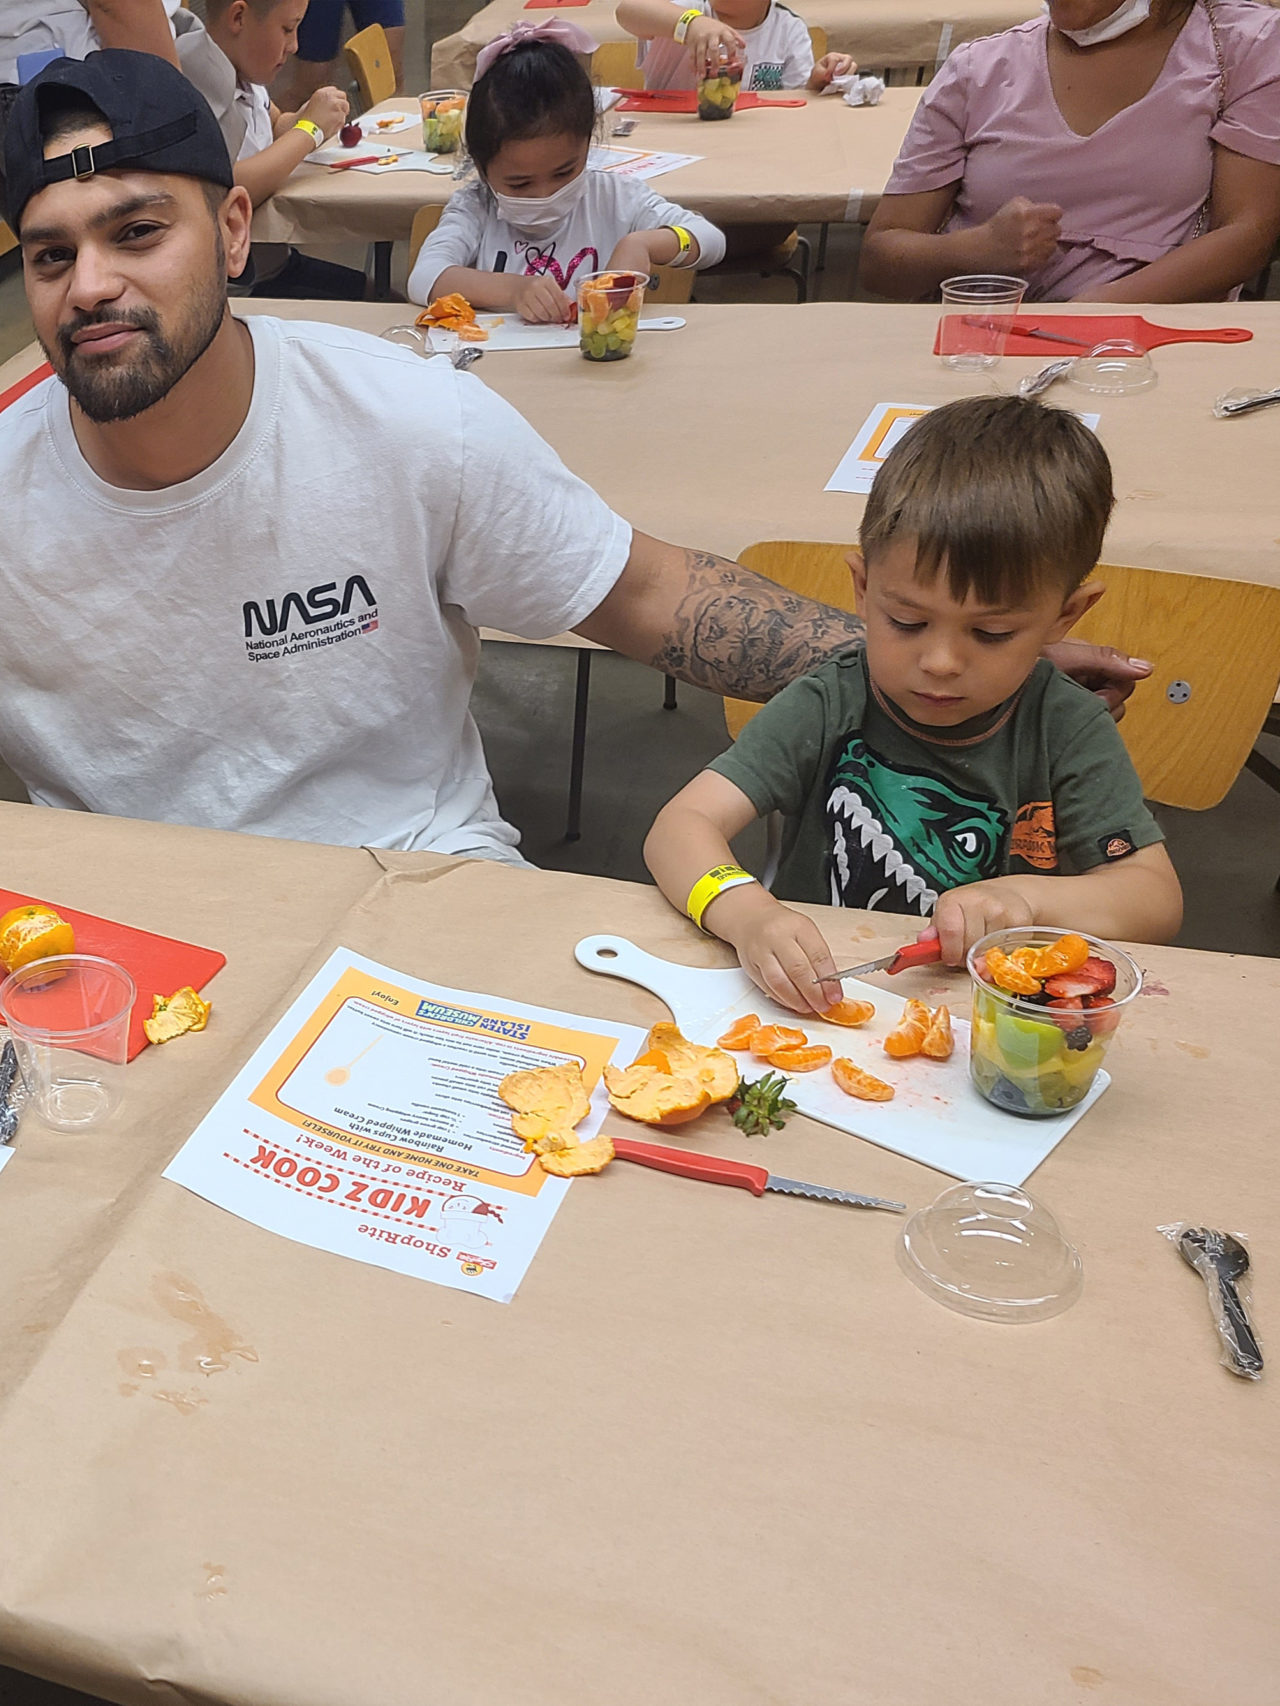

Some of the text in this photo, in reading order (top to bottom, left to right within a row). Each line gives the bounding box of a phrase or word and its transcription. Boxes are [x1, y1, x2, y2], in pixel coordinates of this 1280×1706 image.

[243, 575, 377, 637] NASA
[246, 608, 378, 650] National Aeronautics and
[248, 627, 362, 663] Space Administration
[421, 1001, 480, 1022] MUSEUM
[481, 1017, 531, 1032] ISLAND
[478, 1021, 529, 1040] STATEN
[333, 1106, 366, 1123] Cream
[365, 1118, 411, 1136] Whipped
[301, 1119, 480, 1178] TAKE ONE HOME AND TRY IT YOURSELF!
[348, 1122, 445, 1153] Rainbow Cups with
[412, 1130, 473, 1151] Homemade
[295, 1133, 467, 1193] Recipe of the Week!
[249, 1144, 432, 1219] KIDZ COOK
[357, 1223, 452, 1258] ShopRite
